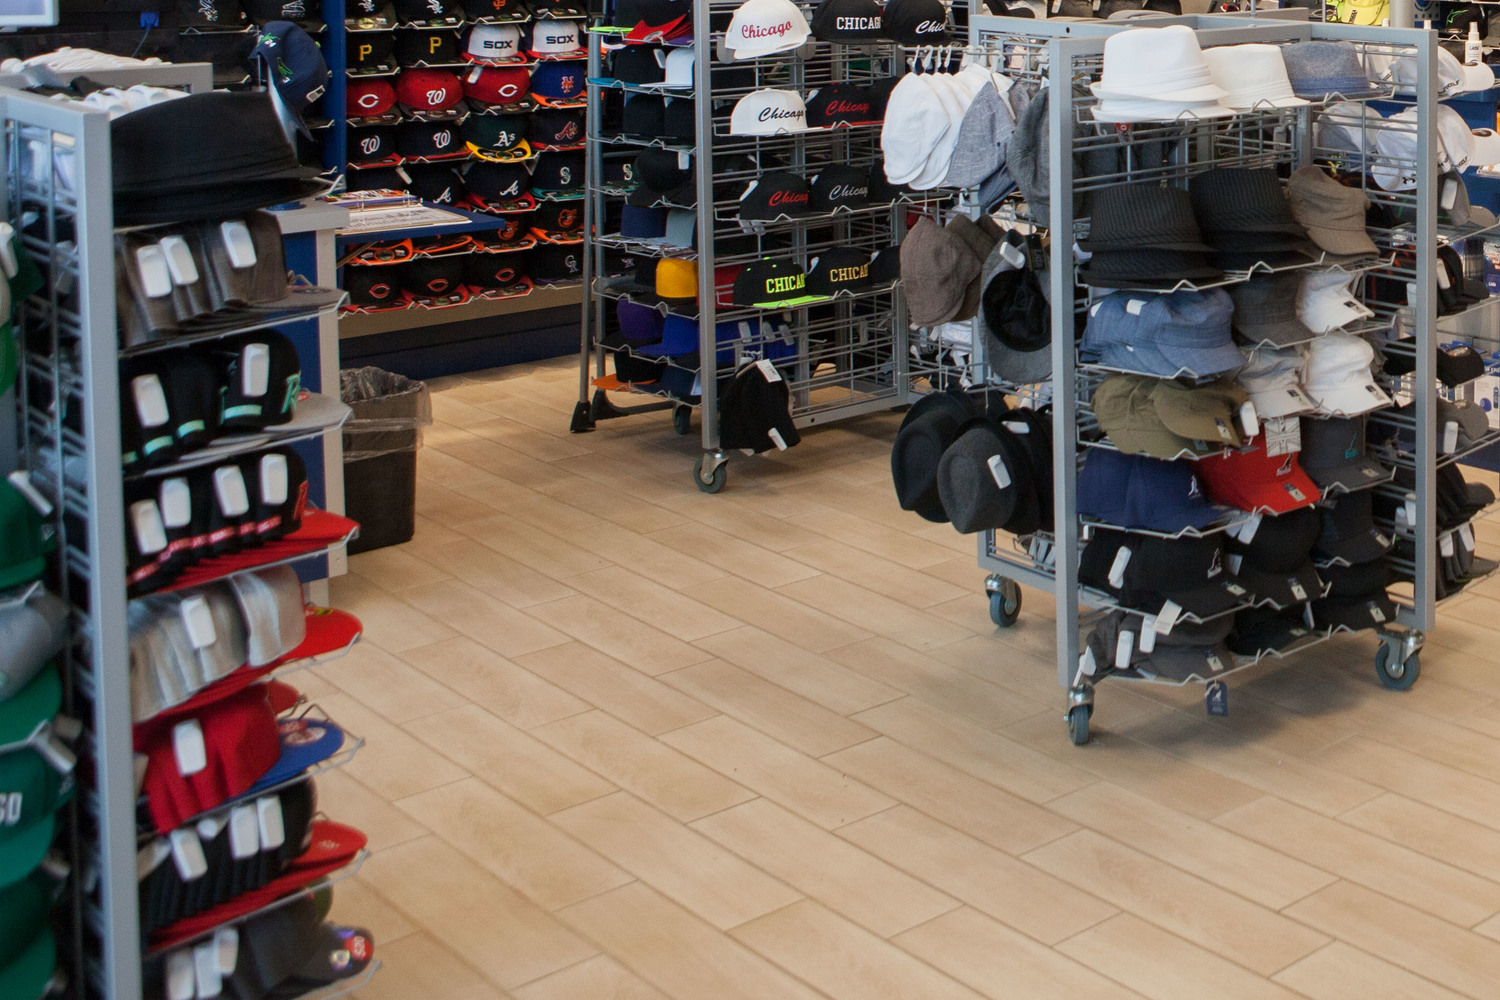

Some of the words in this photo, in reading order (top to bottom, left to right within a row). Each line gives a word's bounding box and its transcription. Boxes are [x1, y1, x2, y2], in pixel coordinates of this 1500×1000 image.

[741, 20, 793, 38] Chicago
[836, 16, 881, 30] CHICAG
[915, 20, 945, 34] Chic
[483, 39, 513, 50] SOX
[545, 34, 575, 45] SOX
